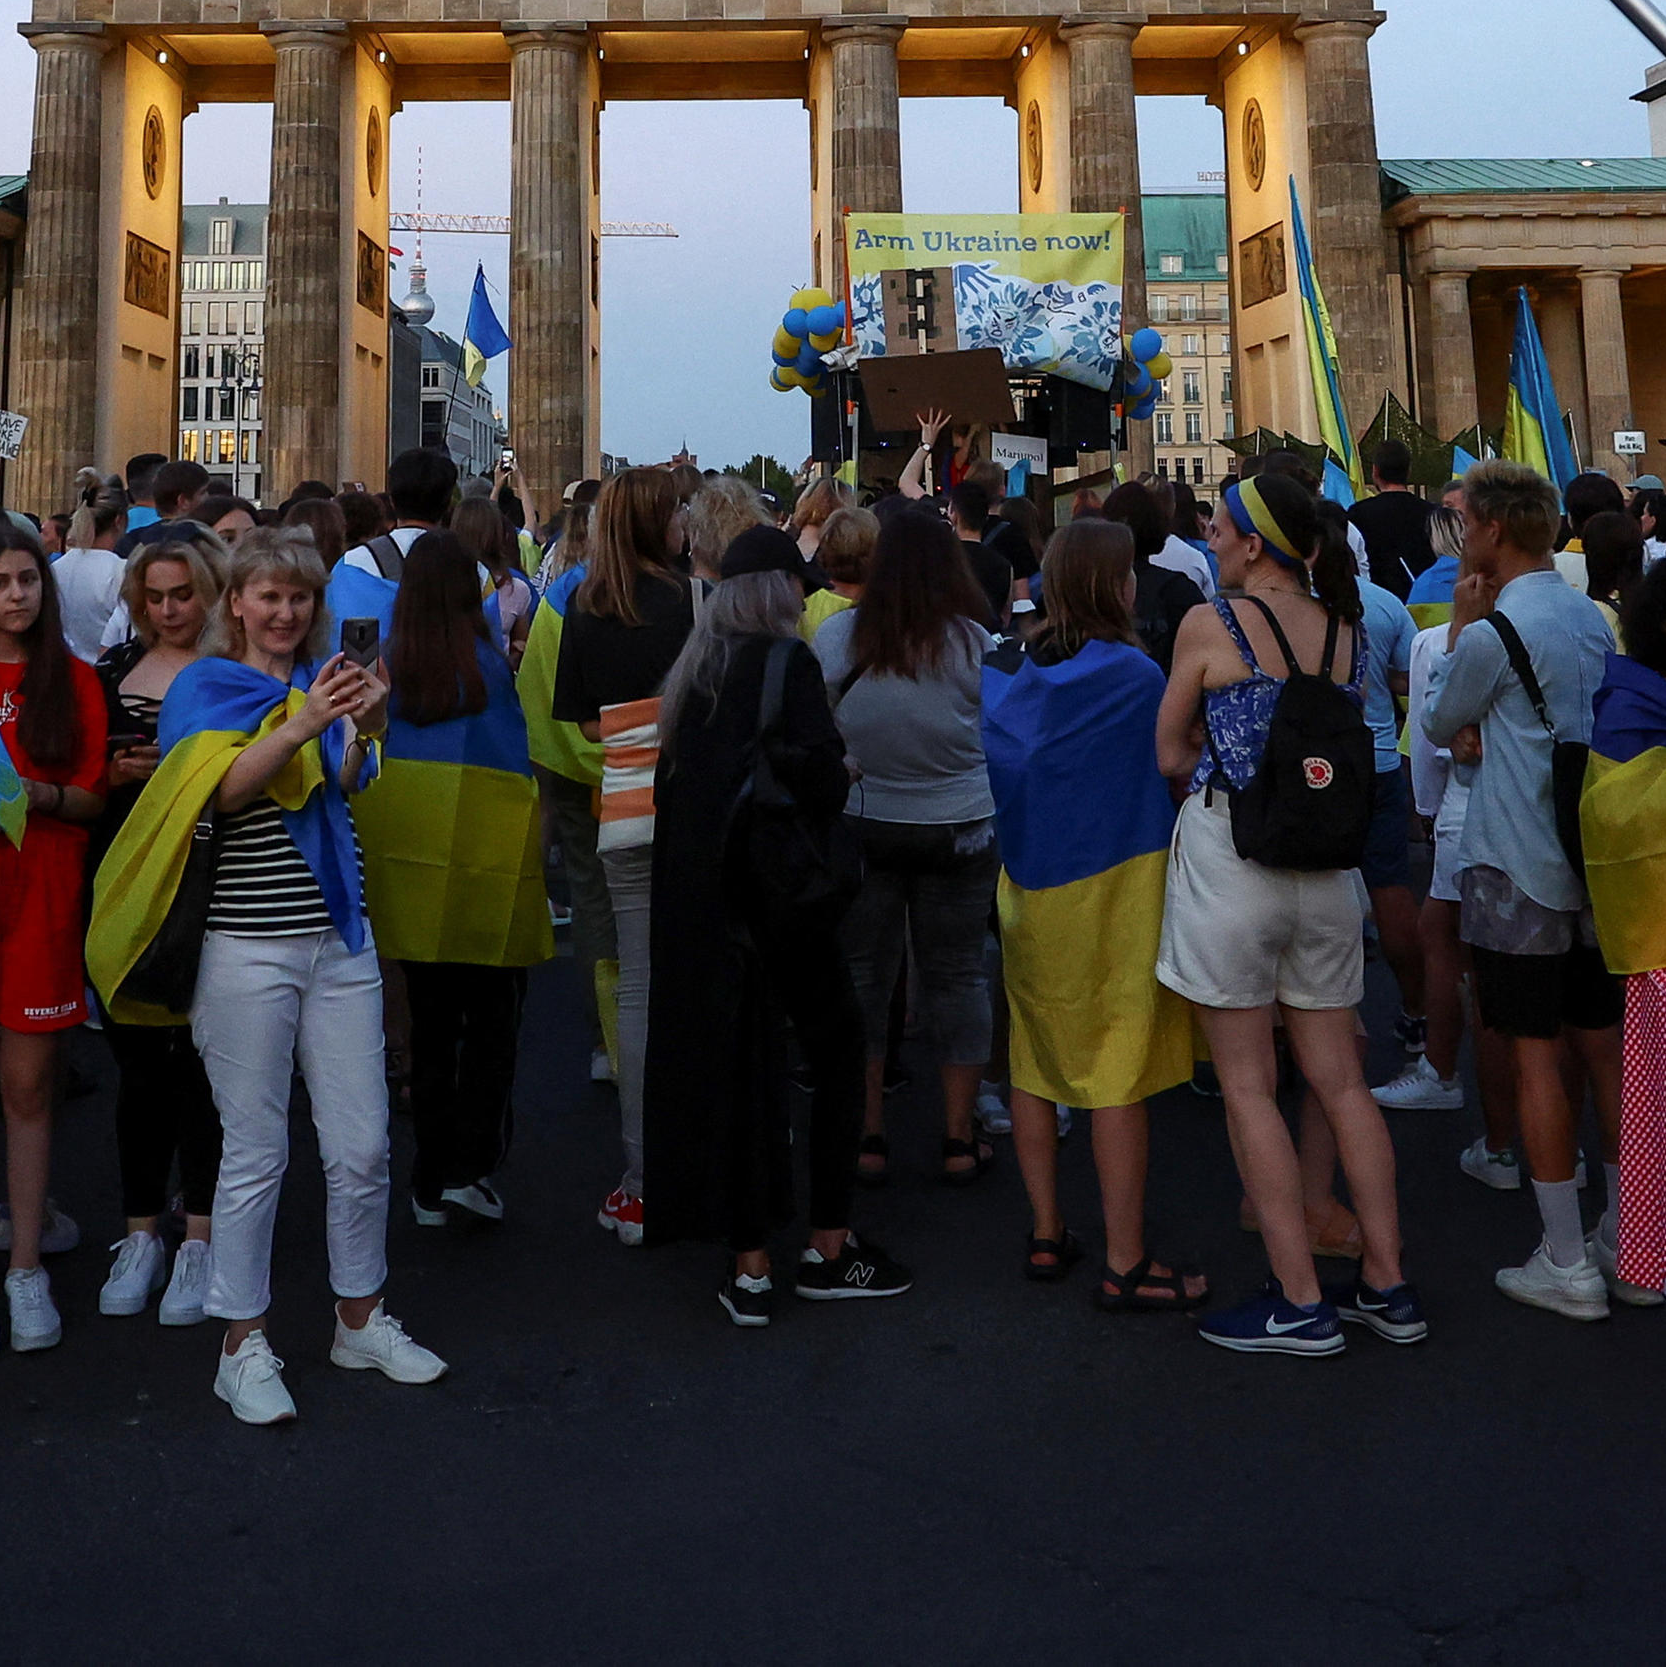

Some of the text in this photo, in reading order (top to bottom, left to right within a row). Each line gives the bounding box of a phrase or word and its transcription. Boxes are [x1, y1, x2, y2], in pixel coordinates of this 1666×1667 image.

[854, 228, 1111, 252] Arm Ukraine now!
[995, 446, 1044, 463] Mariupol
